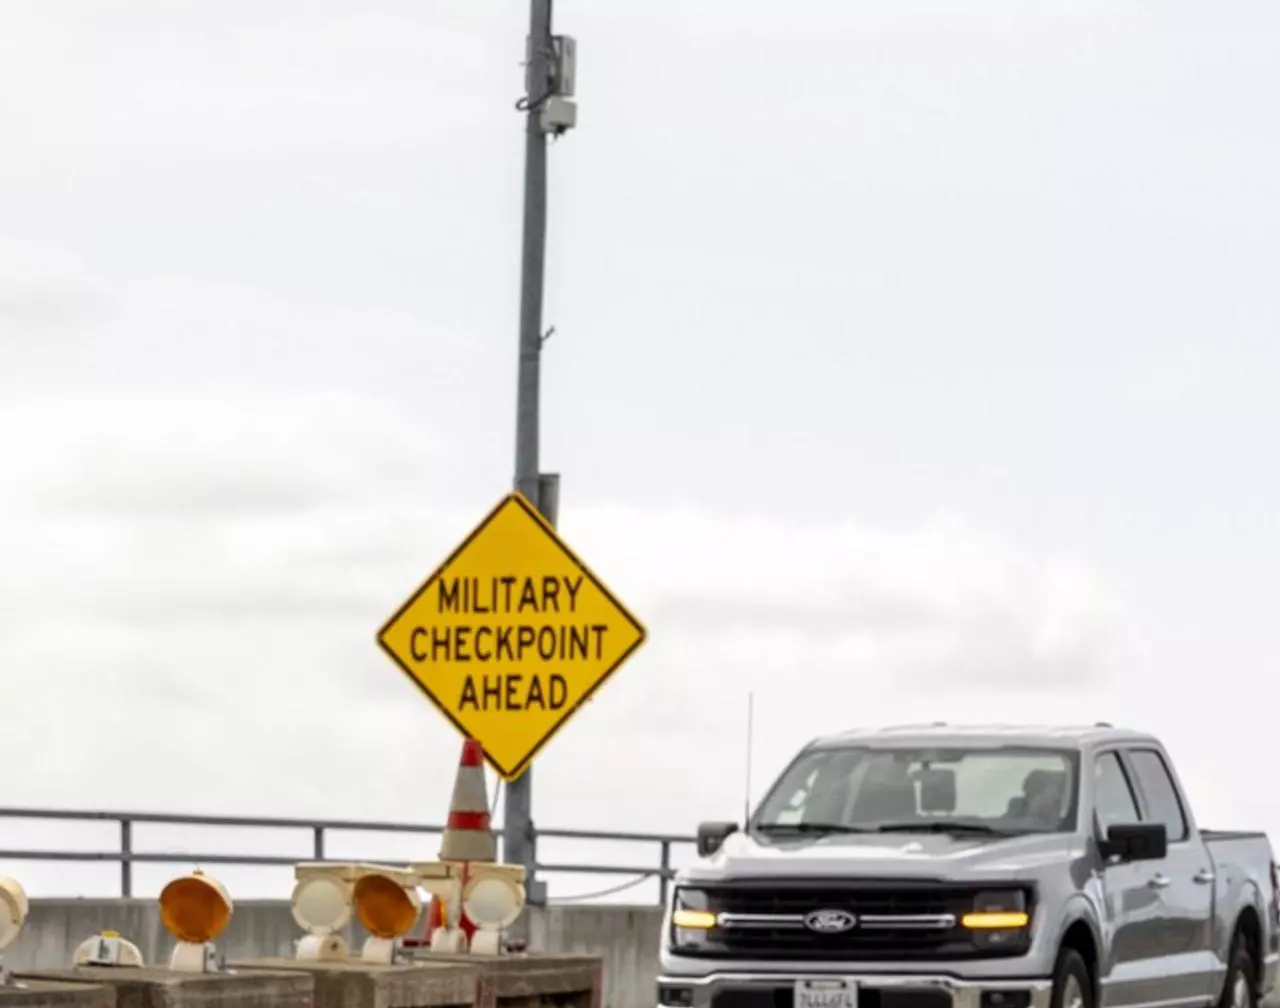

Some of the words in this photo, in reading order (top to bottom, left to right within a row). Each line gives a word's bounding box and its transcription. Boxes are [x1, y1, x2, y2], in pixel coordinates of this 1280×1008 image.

[437, 576, 583, 614] MILITARY
[409, 625, 608, 662] CHECKPOINT
[458, 673, 568, 711] AHEAD
